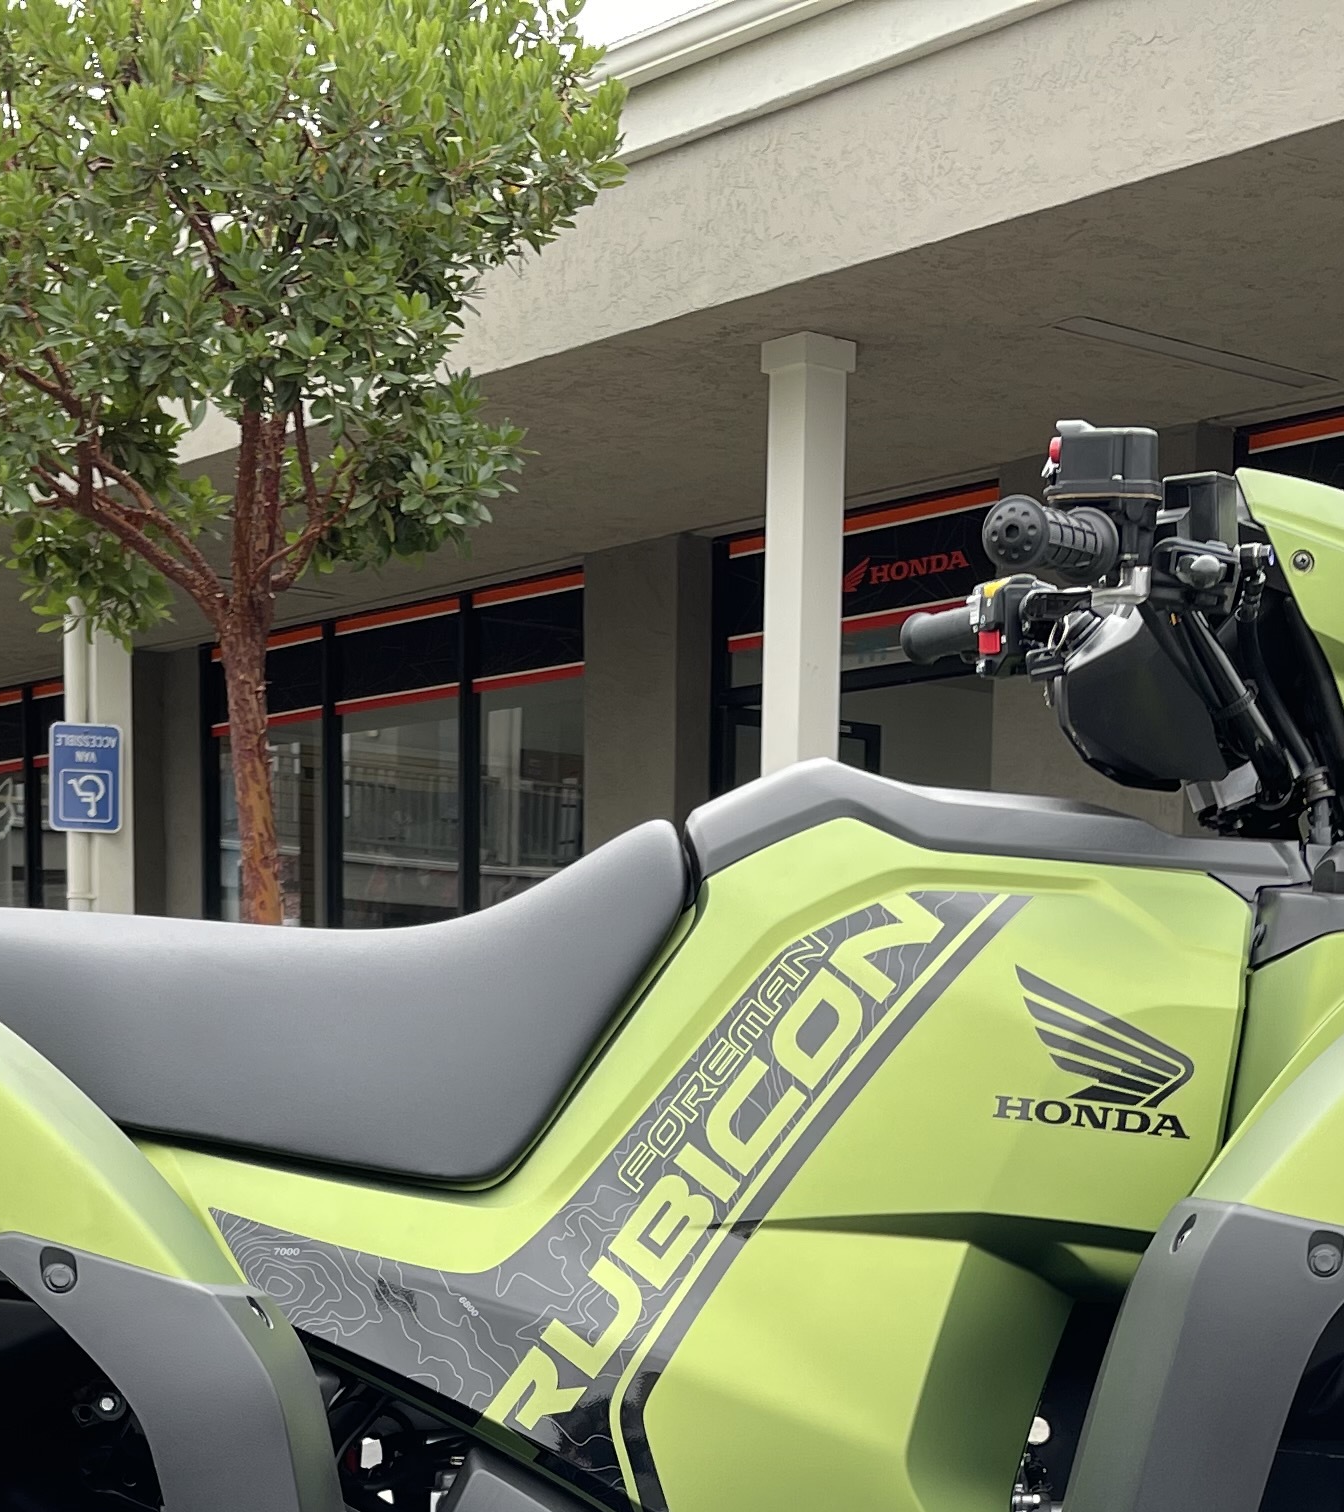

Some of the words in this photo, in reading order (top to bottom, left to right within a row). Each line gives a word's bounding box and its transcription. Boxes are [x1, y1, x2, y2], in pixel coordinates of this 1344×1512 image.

[869, 550, 971, 584] HONDA
[55, 734, 117, 748] ACCESSIBLE
[75, 751, 97, 763] VAN
[618, 933, 828, 1193] FOREMAN
[993, 1096, 1190, 1139] HONDA
[483, 891, 945, 1430] RUBICON
[273, 1247, 300, 1256] 7000
